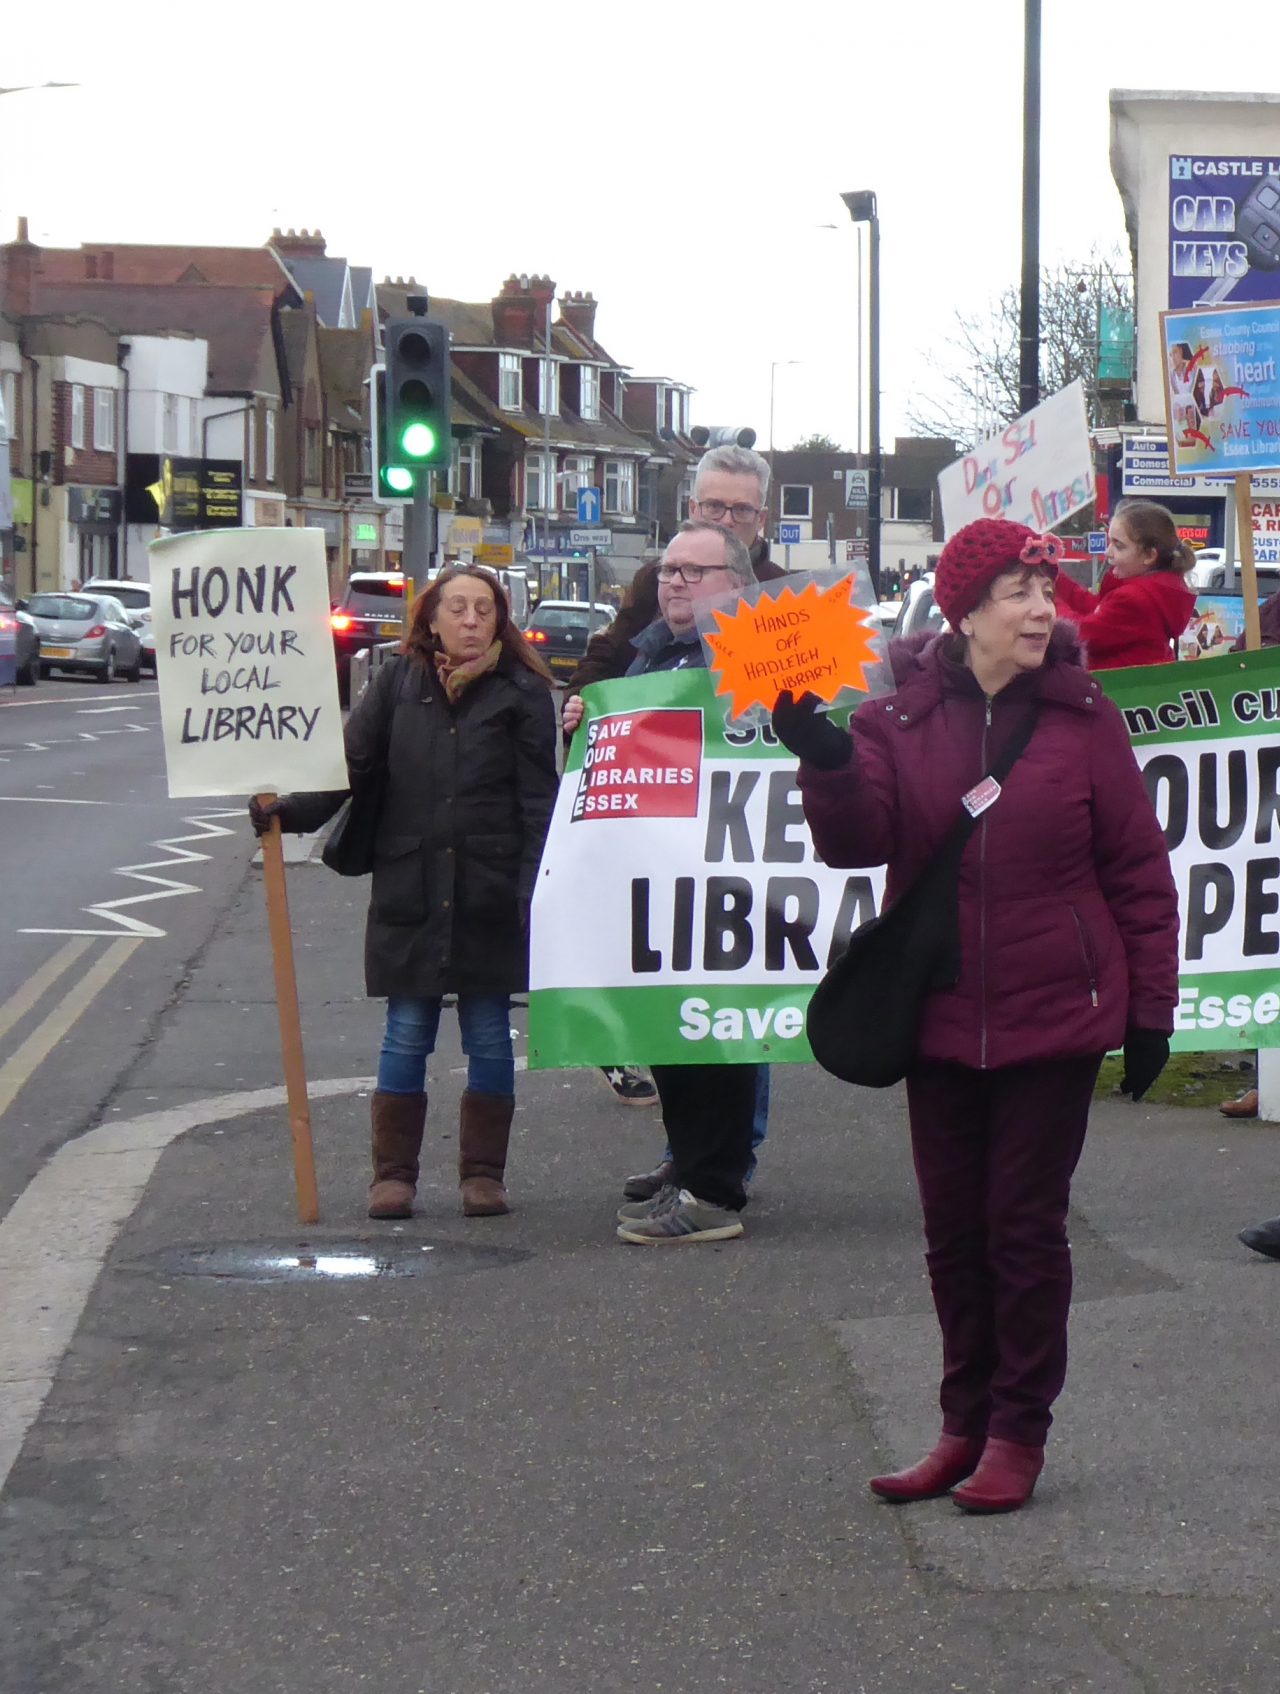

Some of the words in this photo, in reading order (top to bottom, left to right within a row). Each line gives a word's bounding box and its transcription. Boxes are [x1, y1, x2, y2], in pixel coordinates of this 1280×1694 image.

[1193, 162, 1263, 176] CASTLE
[1173, 195, 1235, 232] CAR
[1173, 240, 1248, 277] KEYS
[1224, 324, 1250, 336] County
[1252, 322, 1280, 333] Council
[1213, 341, 1255, 356] stabbing
[1234, 357, 1277, 383] heart
[1220, 420, 1251, 440] SAVE
[1133, 443, 1156, 451] Auto
[1224, 442, 1249, 456] Essex
[1133, 476, 1193, 486] Commercial
[574, 533, 589, 542] One
[592, 535, 608, 543] way
[782, 528, 799, 538] OUT
[1091, 538, 1105, 547] OUT
[171, 565, 297, 620] HONK
[754, 609, 810, 633] HANDS
[170, 631, 223, 660] FOR
[224, 630, 304, 662] YOUR
[776, 631, 802, 651] OFF
[744, 648, 819, 680] HADLEIGH
[773, 657, 838, 692] LIBRARY!
[201, 665, 281, 694] LOCAL
[181, 703, 321, 744] LIBRARY
[1122, 689, 1220, 736] ncil
[588, 720, 632, 744] SAVE
[585, 746, 616, 768] OUR
[579, 768, 693, 792] LIBRARIES
[573, 793, 638, 817] ESSEX
[704, 771, 807, 863] KE
[631, 876, 876, 973] LIBRA
[679, 997, 803, 1041] Save
